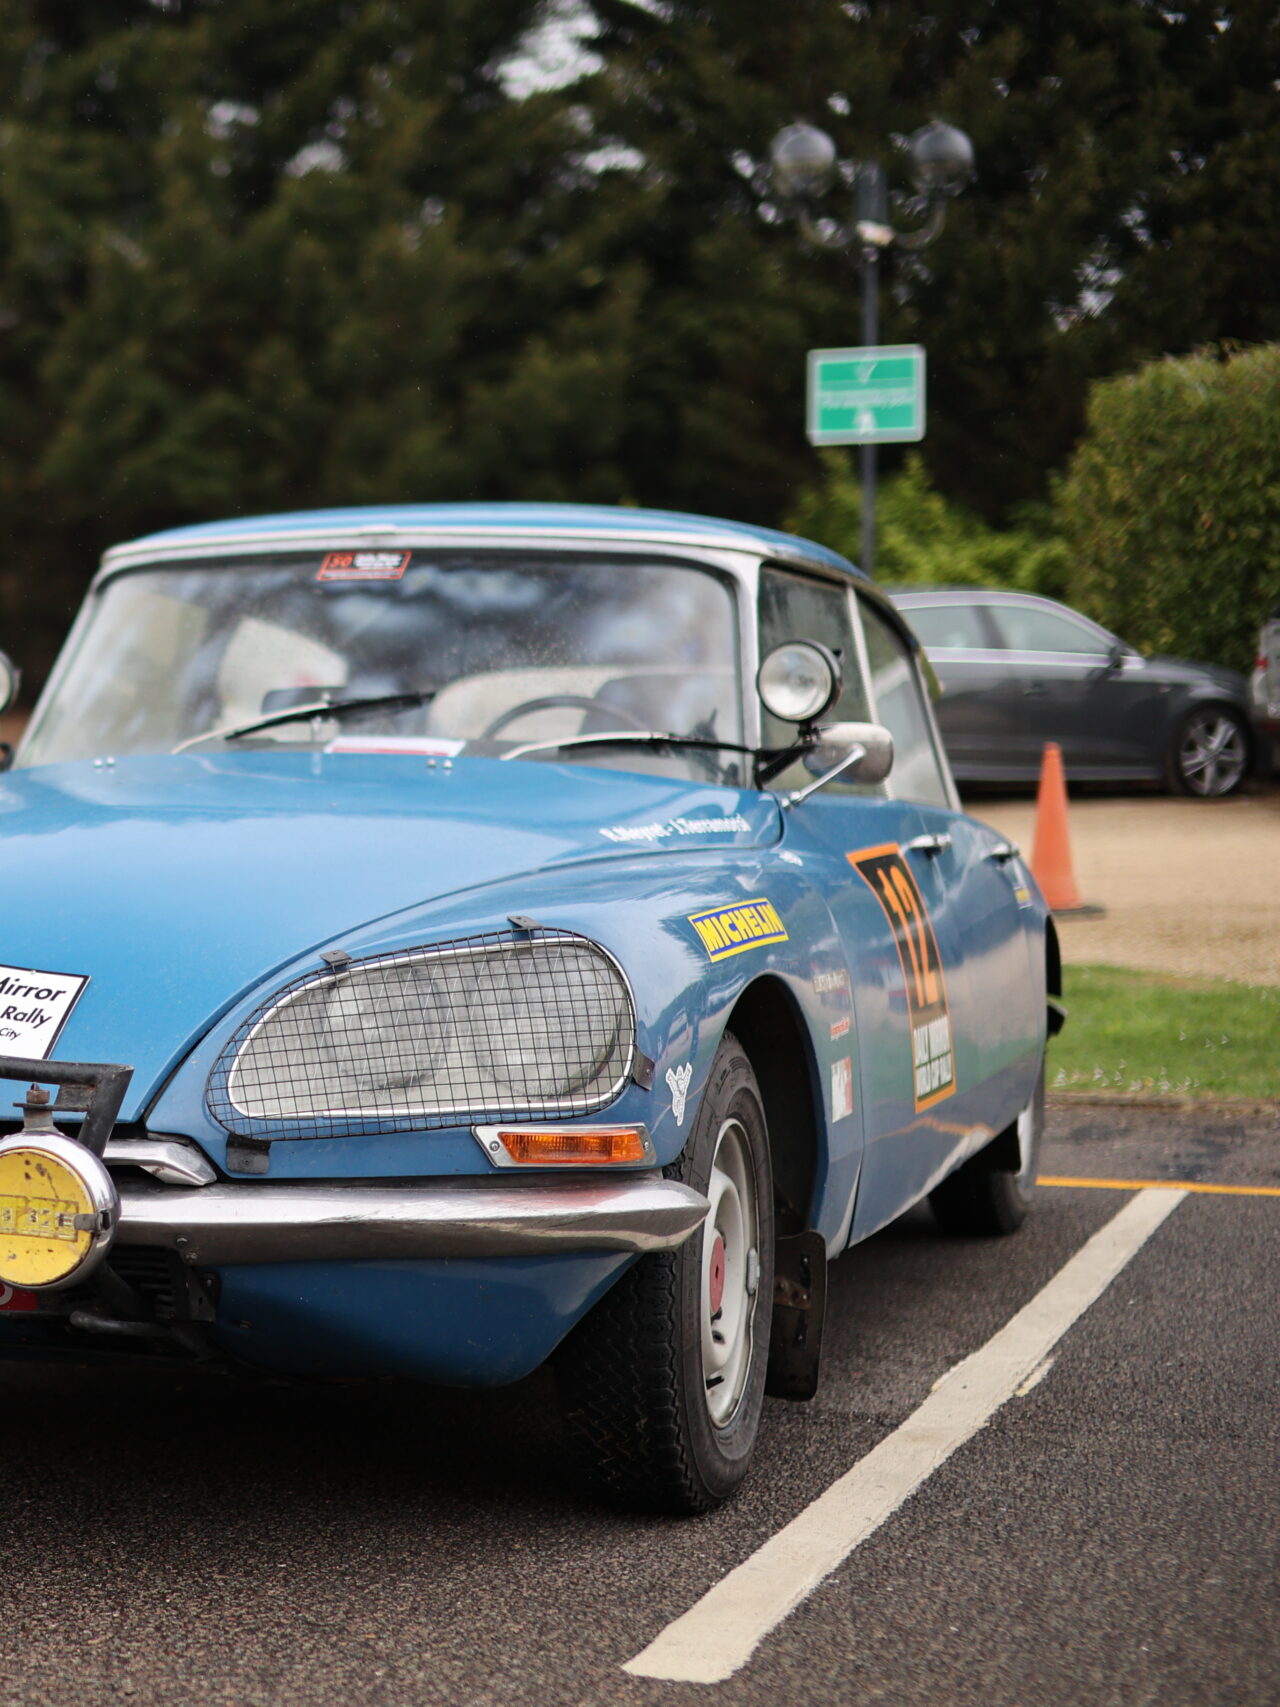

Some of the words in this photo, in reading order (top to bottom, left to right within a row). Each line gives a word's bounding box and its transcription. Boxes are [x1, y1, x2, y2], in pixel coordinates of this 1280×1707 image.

[695, 904, 785, 952] MICHELIN
[876, 864, 938, 1008] 12
[0, 1005, 52, 1029] Rally
